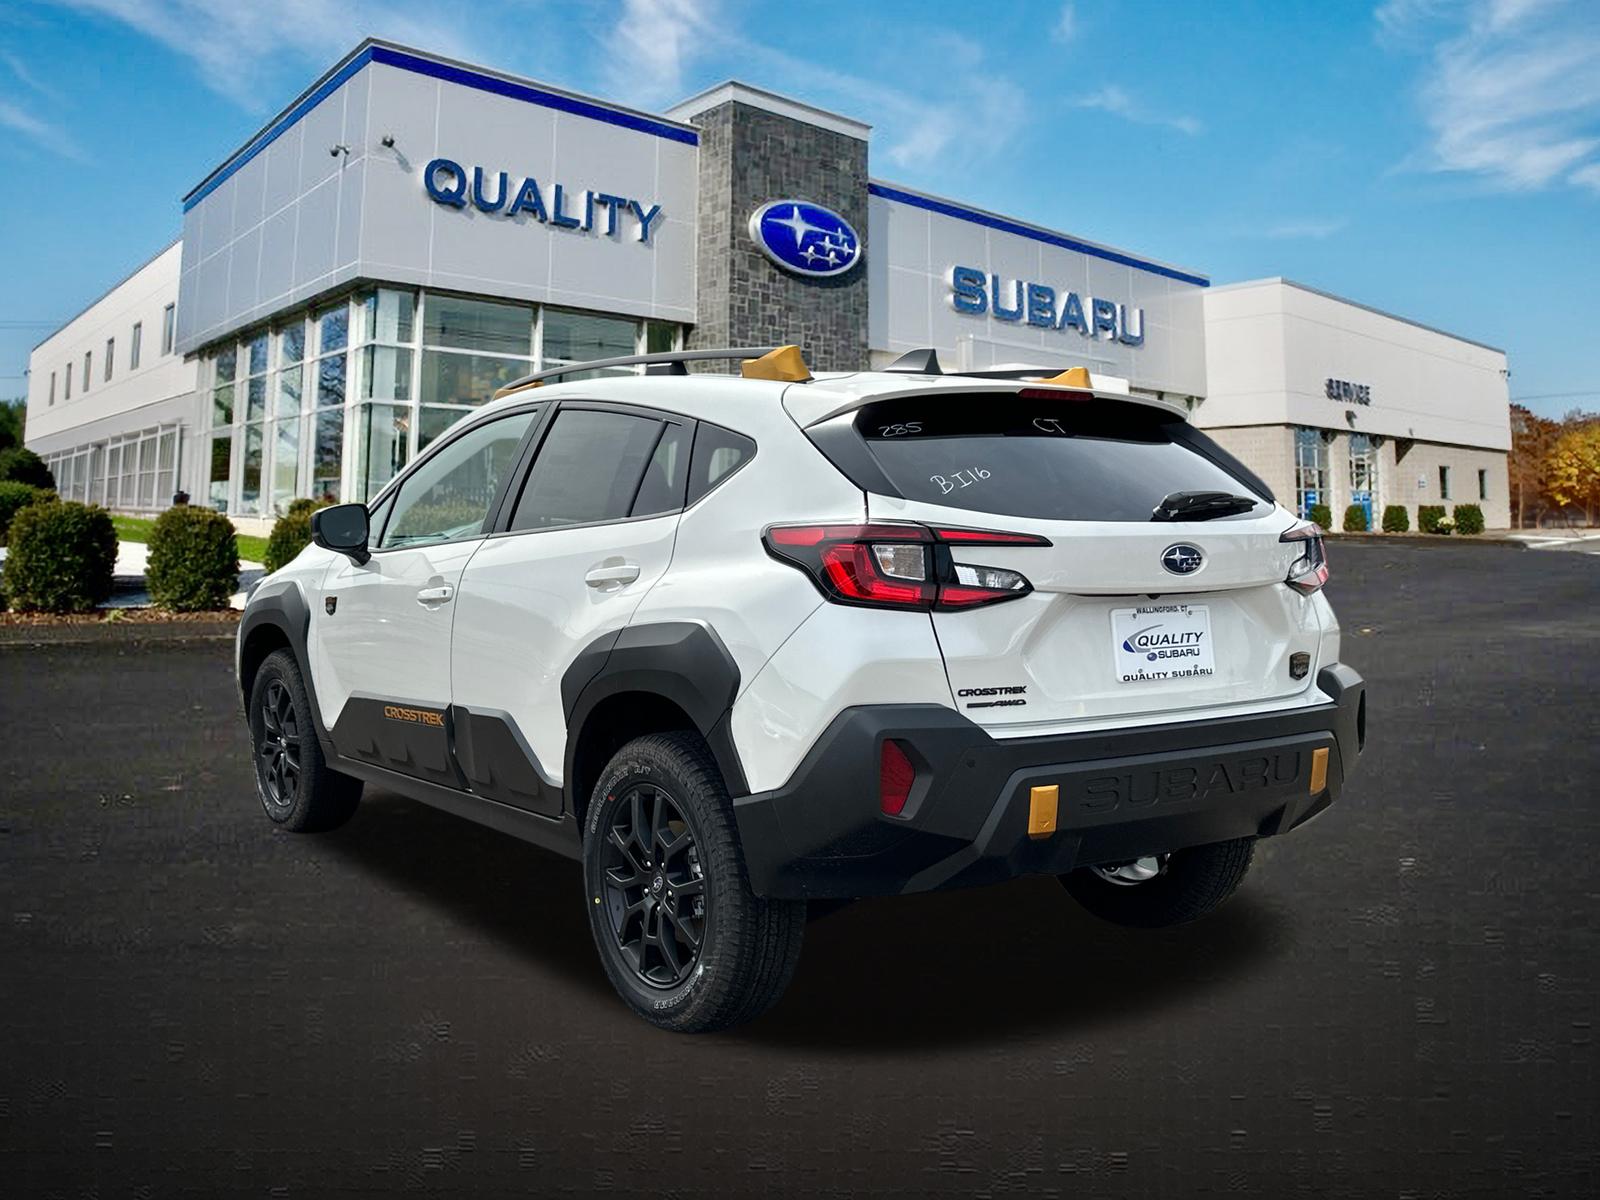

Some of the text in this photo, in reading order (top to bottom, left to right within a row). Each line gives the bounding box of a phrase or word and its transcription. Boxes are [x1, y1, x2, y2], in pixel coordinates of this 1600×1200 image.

[424, 158, 661, 242] QUALITY
[950, 265, 1145, 346] SUBARU
[1326, 378, 1371, 406] SERVICE
[879, 422, 922, 437] 285
[1033, 418, 1066, 434] CT
[1138, 632, 1204, 647] QUALITY
[1158, 648, 1200, 659] SUBARU
[1123, 668, 1213, 681] QUALITY SUBARU
[958, 686, 1027, 697] CROSSTREK
[990, 699, 1026, 707] AWD
[384, 706, 444, 725] CROSSTREK
[1080, 755, 1301, 815] SUBARU
